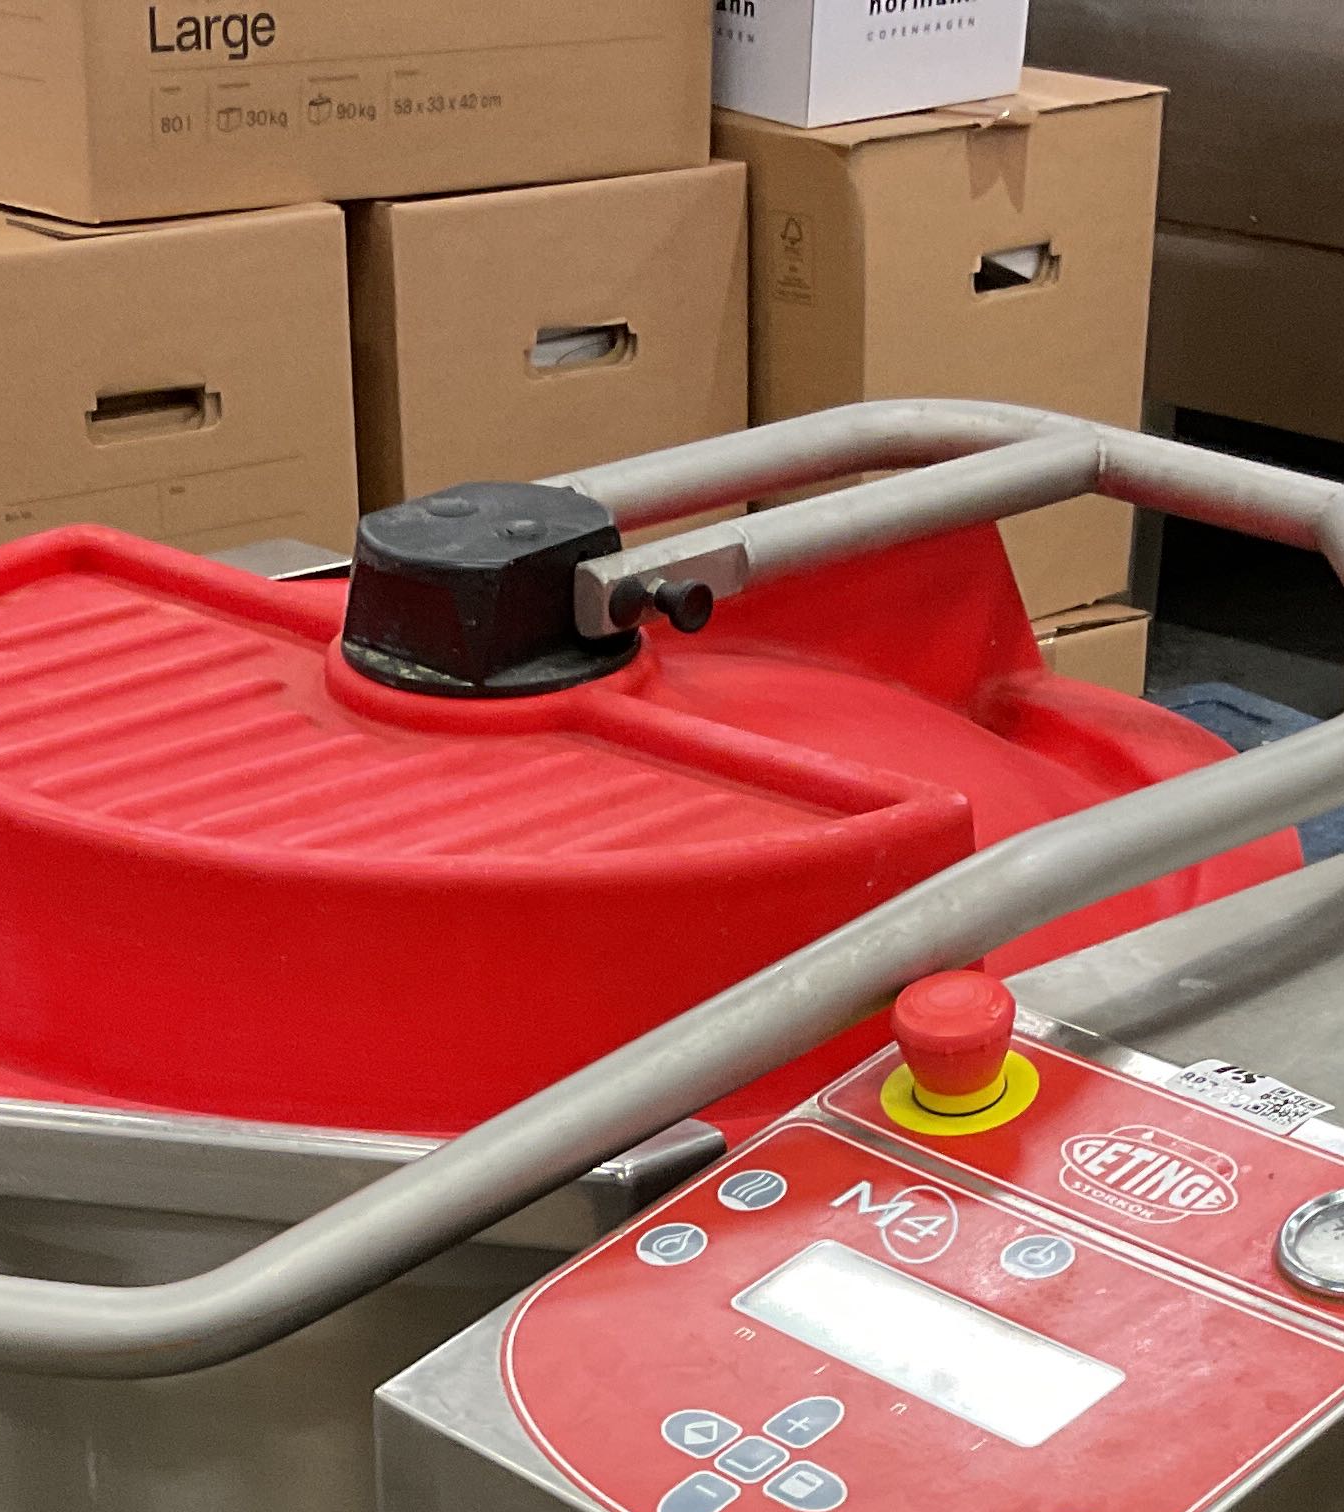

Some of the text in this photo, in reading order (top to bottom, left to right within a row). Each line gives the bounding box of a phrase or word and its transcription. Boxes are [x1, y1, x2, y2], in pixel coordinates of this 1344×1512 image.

[148, 6, 276, 60] Large
[867, 17, 975, 42] COPENHAGEN
[1072, 1139, 1227, 1208] GETINGE
